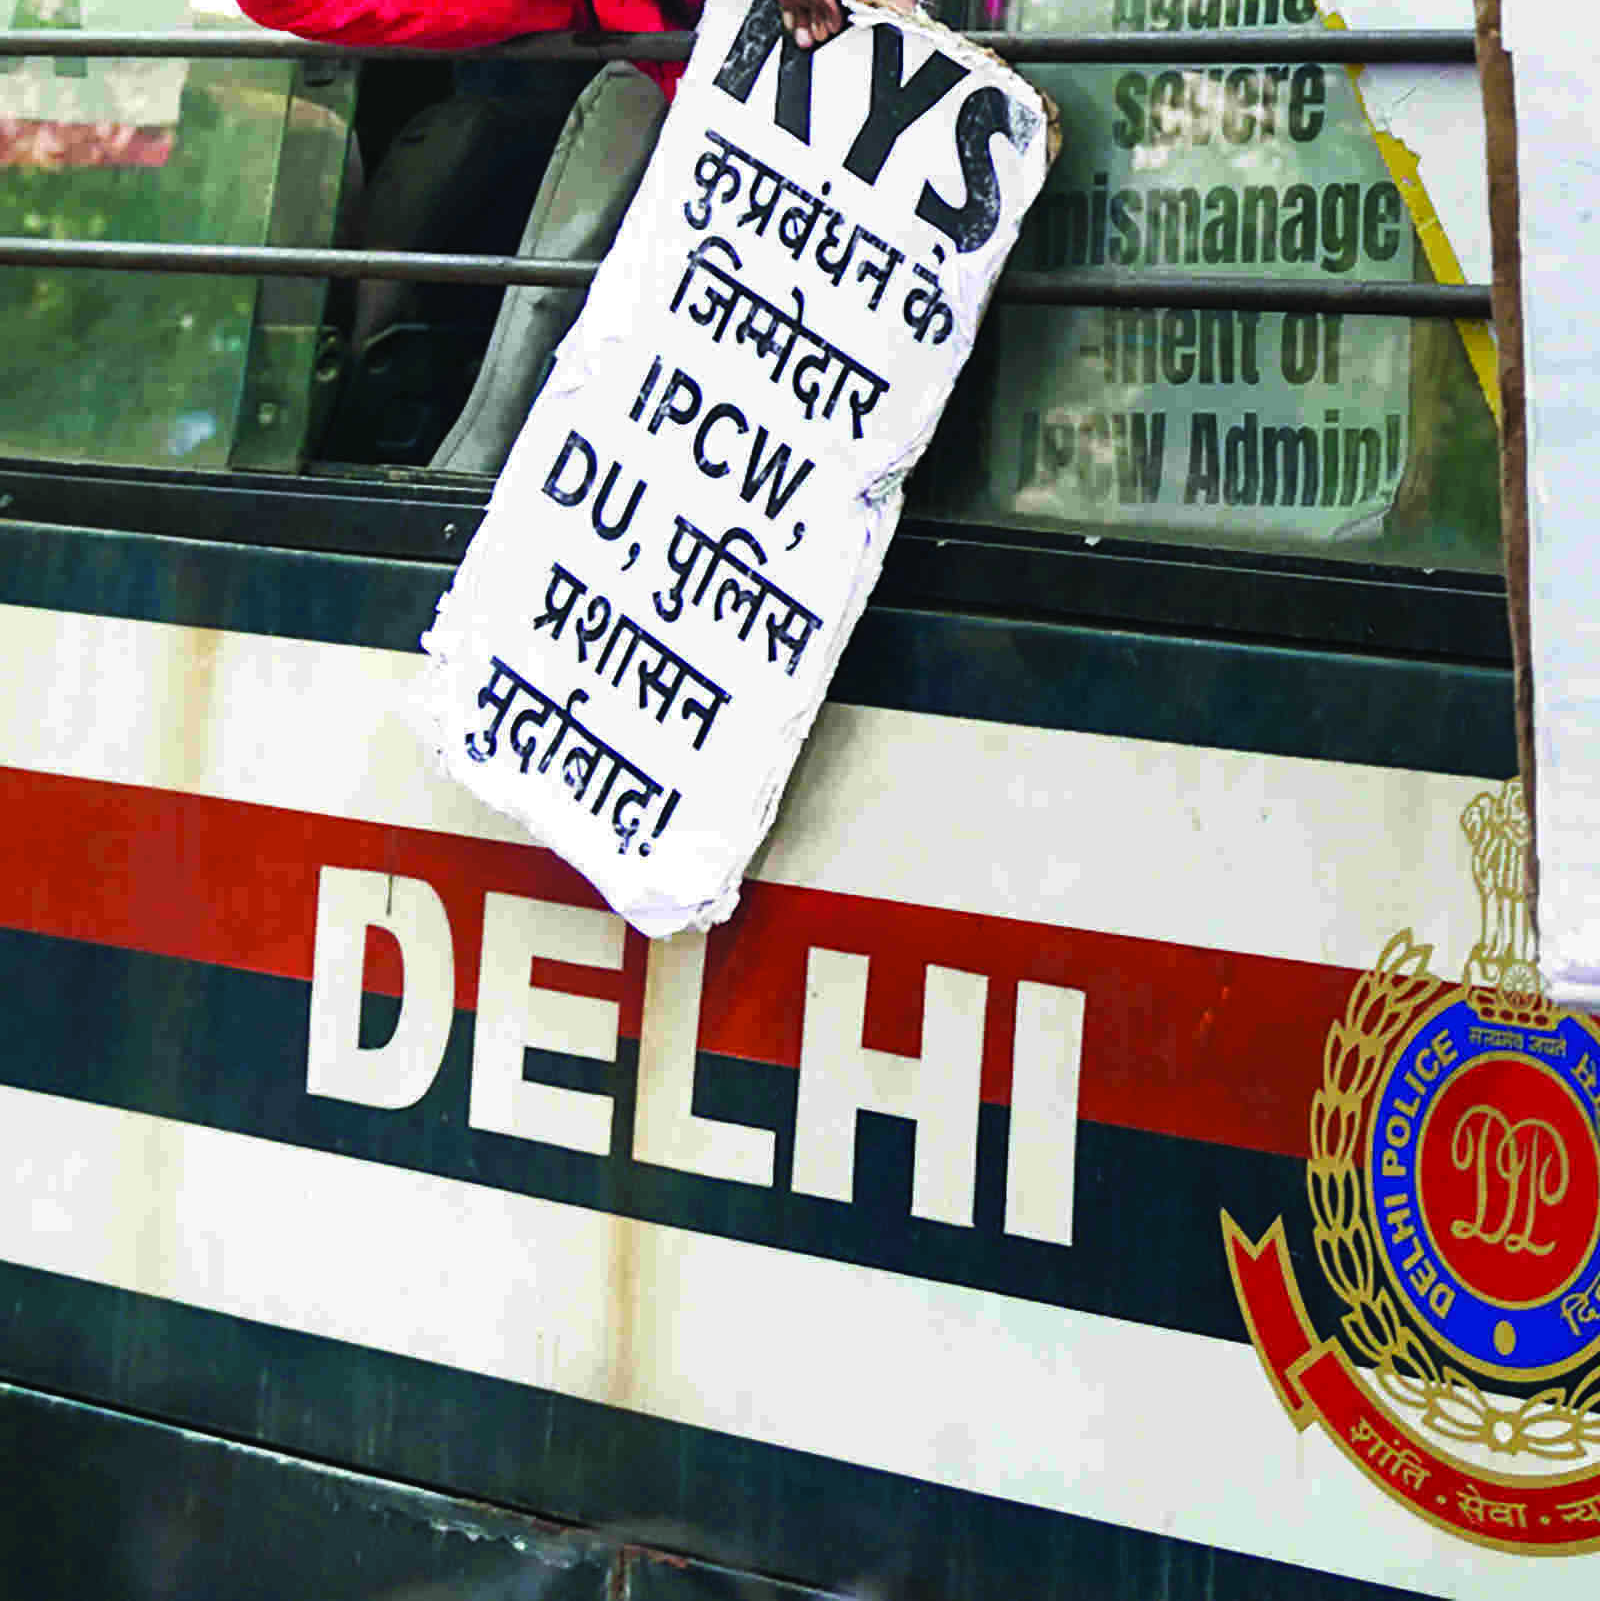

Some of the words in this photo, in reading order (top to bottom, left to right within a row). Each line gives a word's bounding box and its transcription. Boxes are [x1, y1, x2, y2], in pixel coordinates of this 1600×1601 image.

[683, 127, 904, 312] कुप्रबंधन
[901, 243, 955, 346] के
[669, 234, 891, 440] जिम्मेदार
[628, 354, 817, 551] IPCW,
[1185, 409, 1400, 506] Admin!
[541, 429, 648, 571] DU,
[652, 515, 823, 677] पुलिस
[465, 655, 682, 858] मुर्दाबाद!
[533, 562, 733, 751] प्रशासन
[306, 864, 1086, 1247] DELHI
[1381, 1029, 1458, 1177] POLICE
[1384, 1192, 1457, 1319] DELHI
